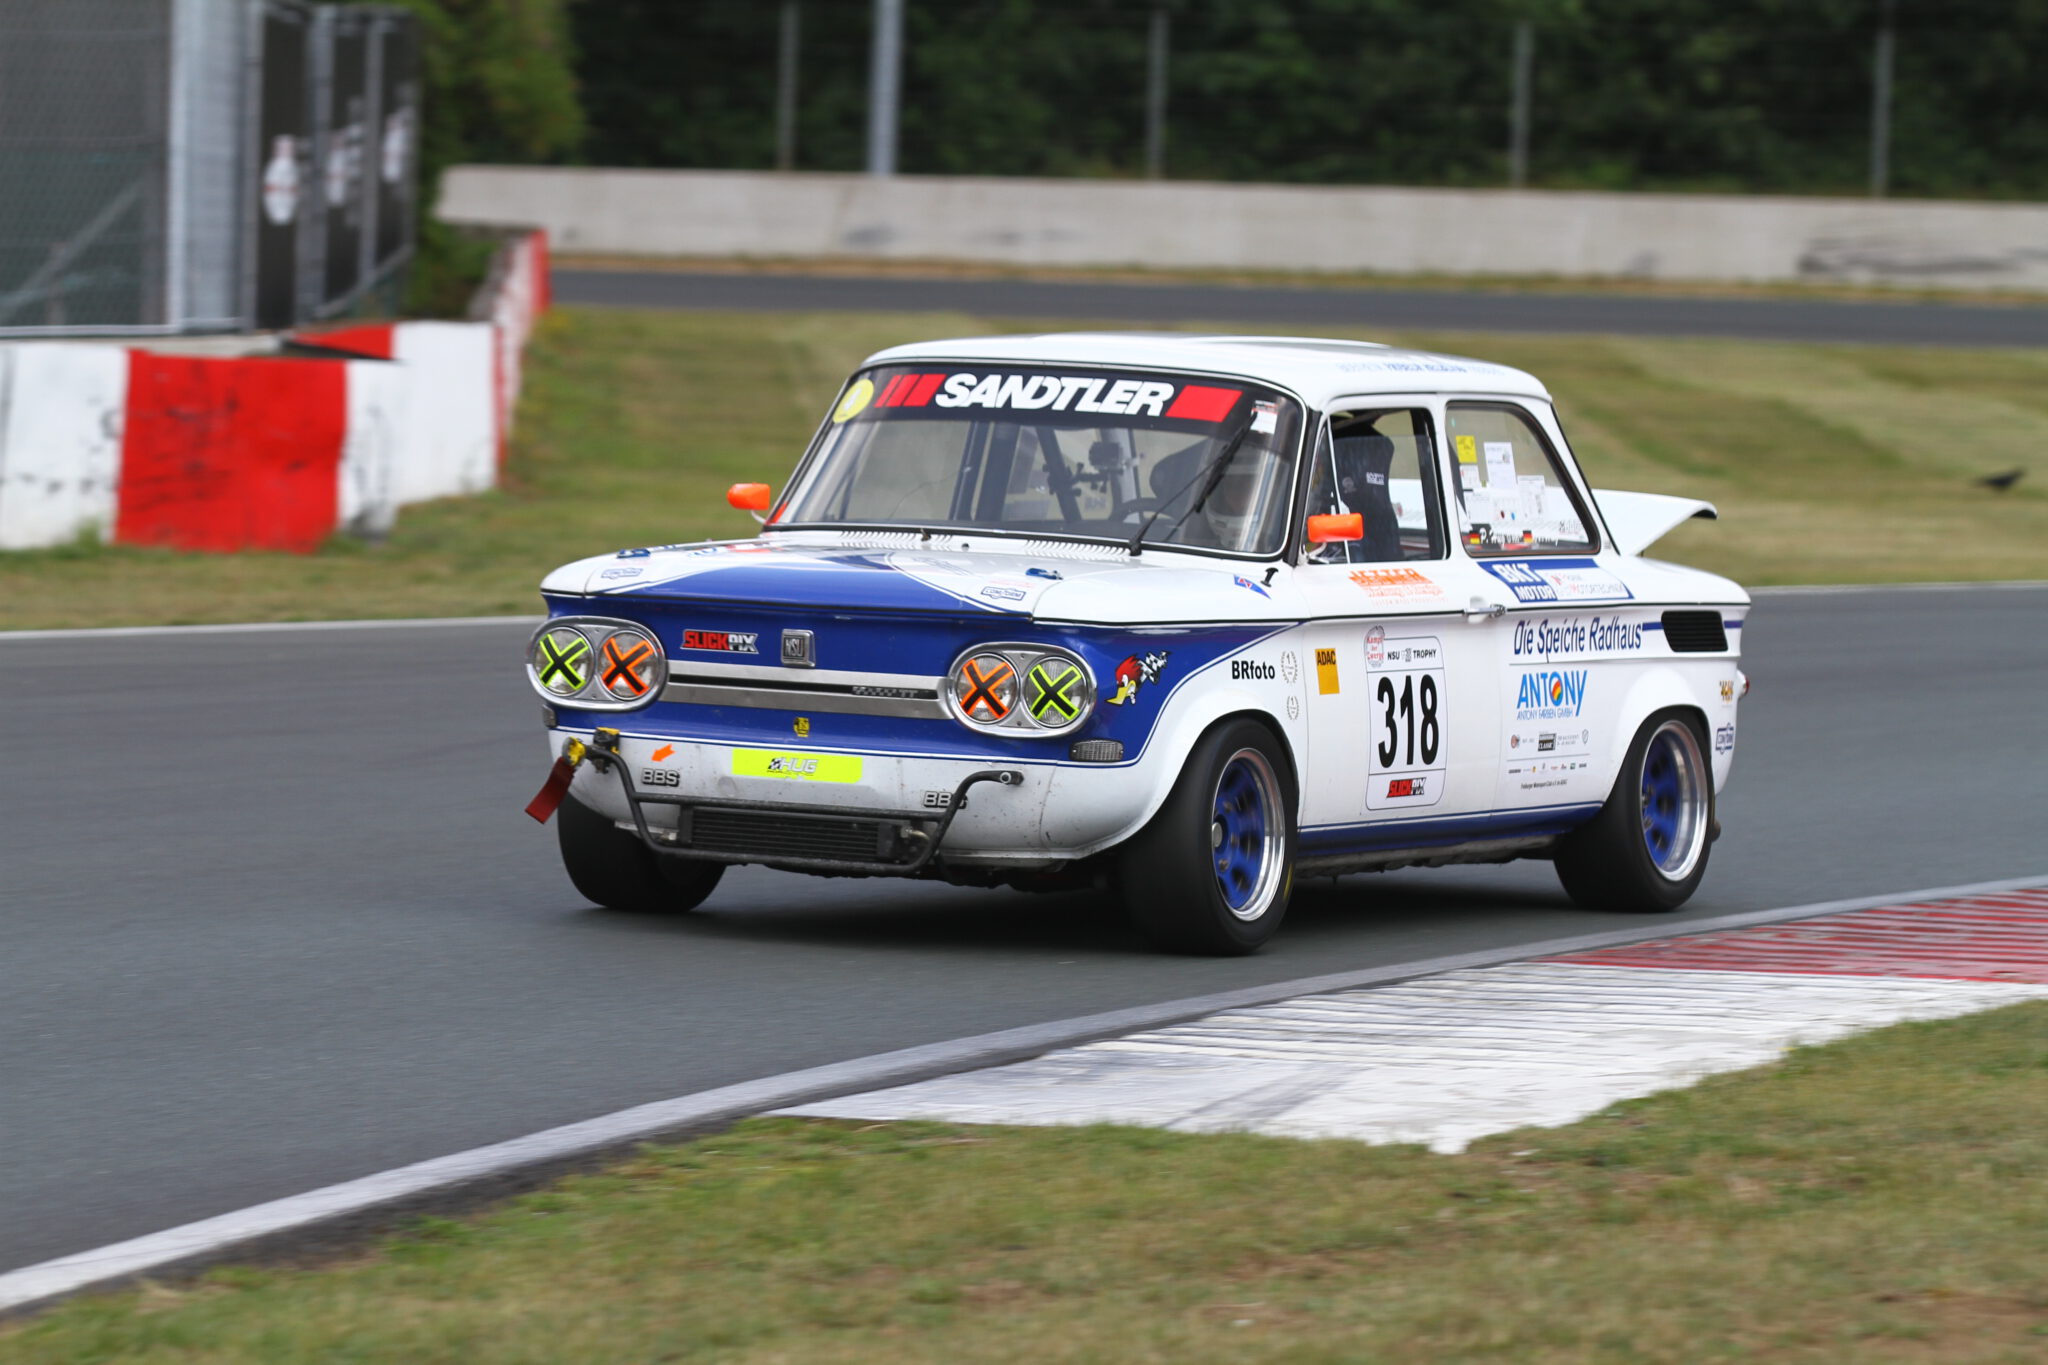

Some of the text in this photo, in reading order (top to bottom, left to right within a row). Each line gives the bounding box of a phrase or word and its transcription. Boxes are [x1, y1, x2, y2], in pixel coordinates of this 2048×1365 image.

[935, 373, 1175, 418] SANDTLER
[1491, 563, 1542, 583] BKT
[1514, 585, 1556, 601] MOTOR
[682, 631, 757, 653] SLICKPIX
[785, 638, 803, 657] NSU
[1514, 616, 1642, 663] Die Speiche Radhaus
[1316, 650, 1337, 666] ADAC
[1387, 650, 1401, 661] NSU
[1412, 648, 1437, 660] TROPHY
[1231, 660, 1276, 680] BRfoto
[1377, 674, 1439, 768] 318
[642, 767, 680, 787] BBS
[923, 790, 968, 810] BB
